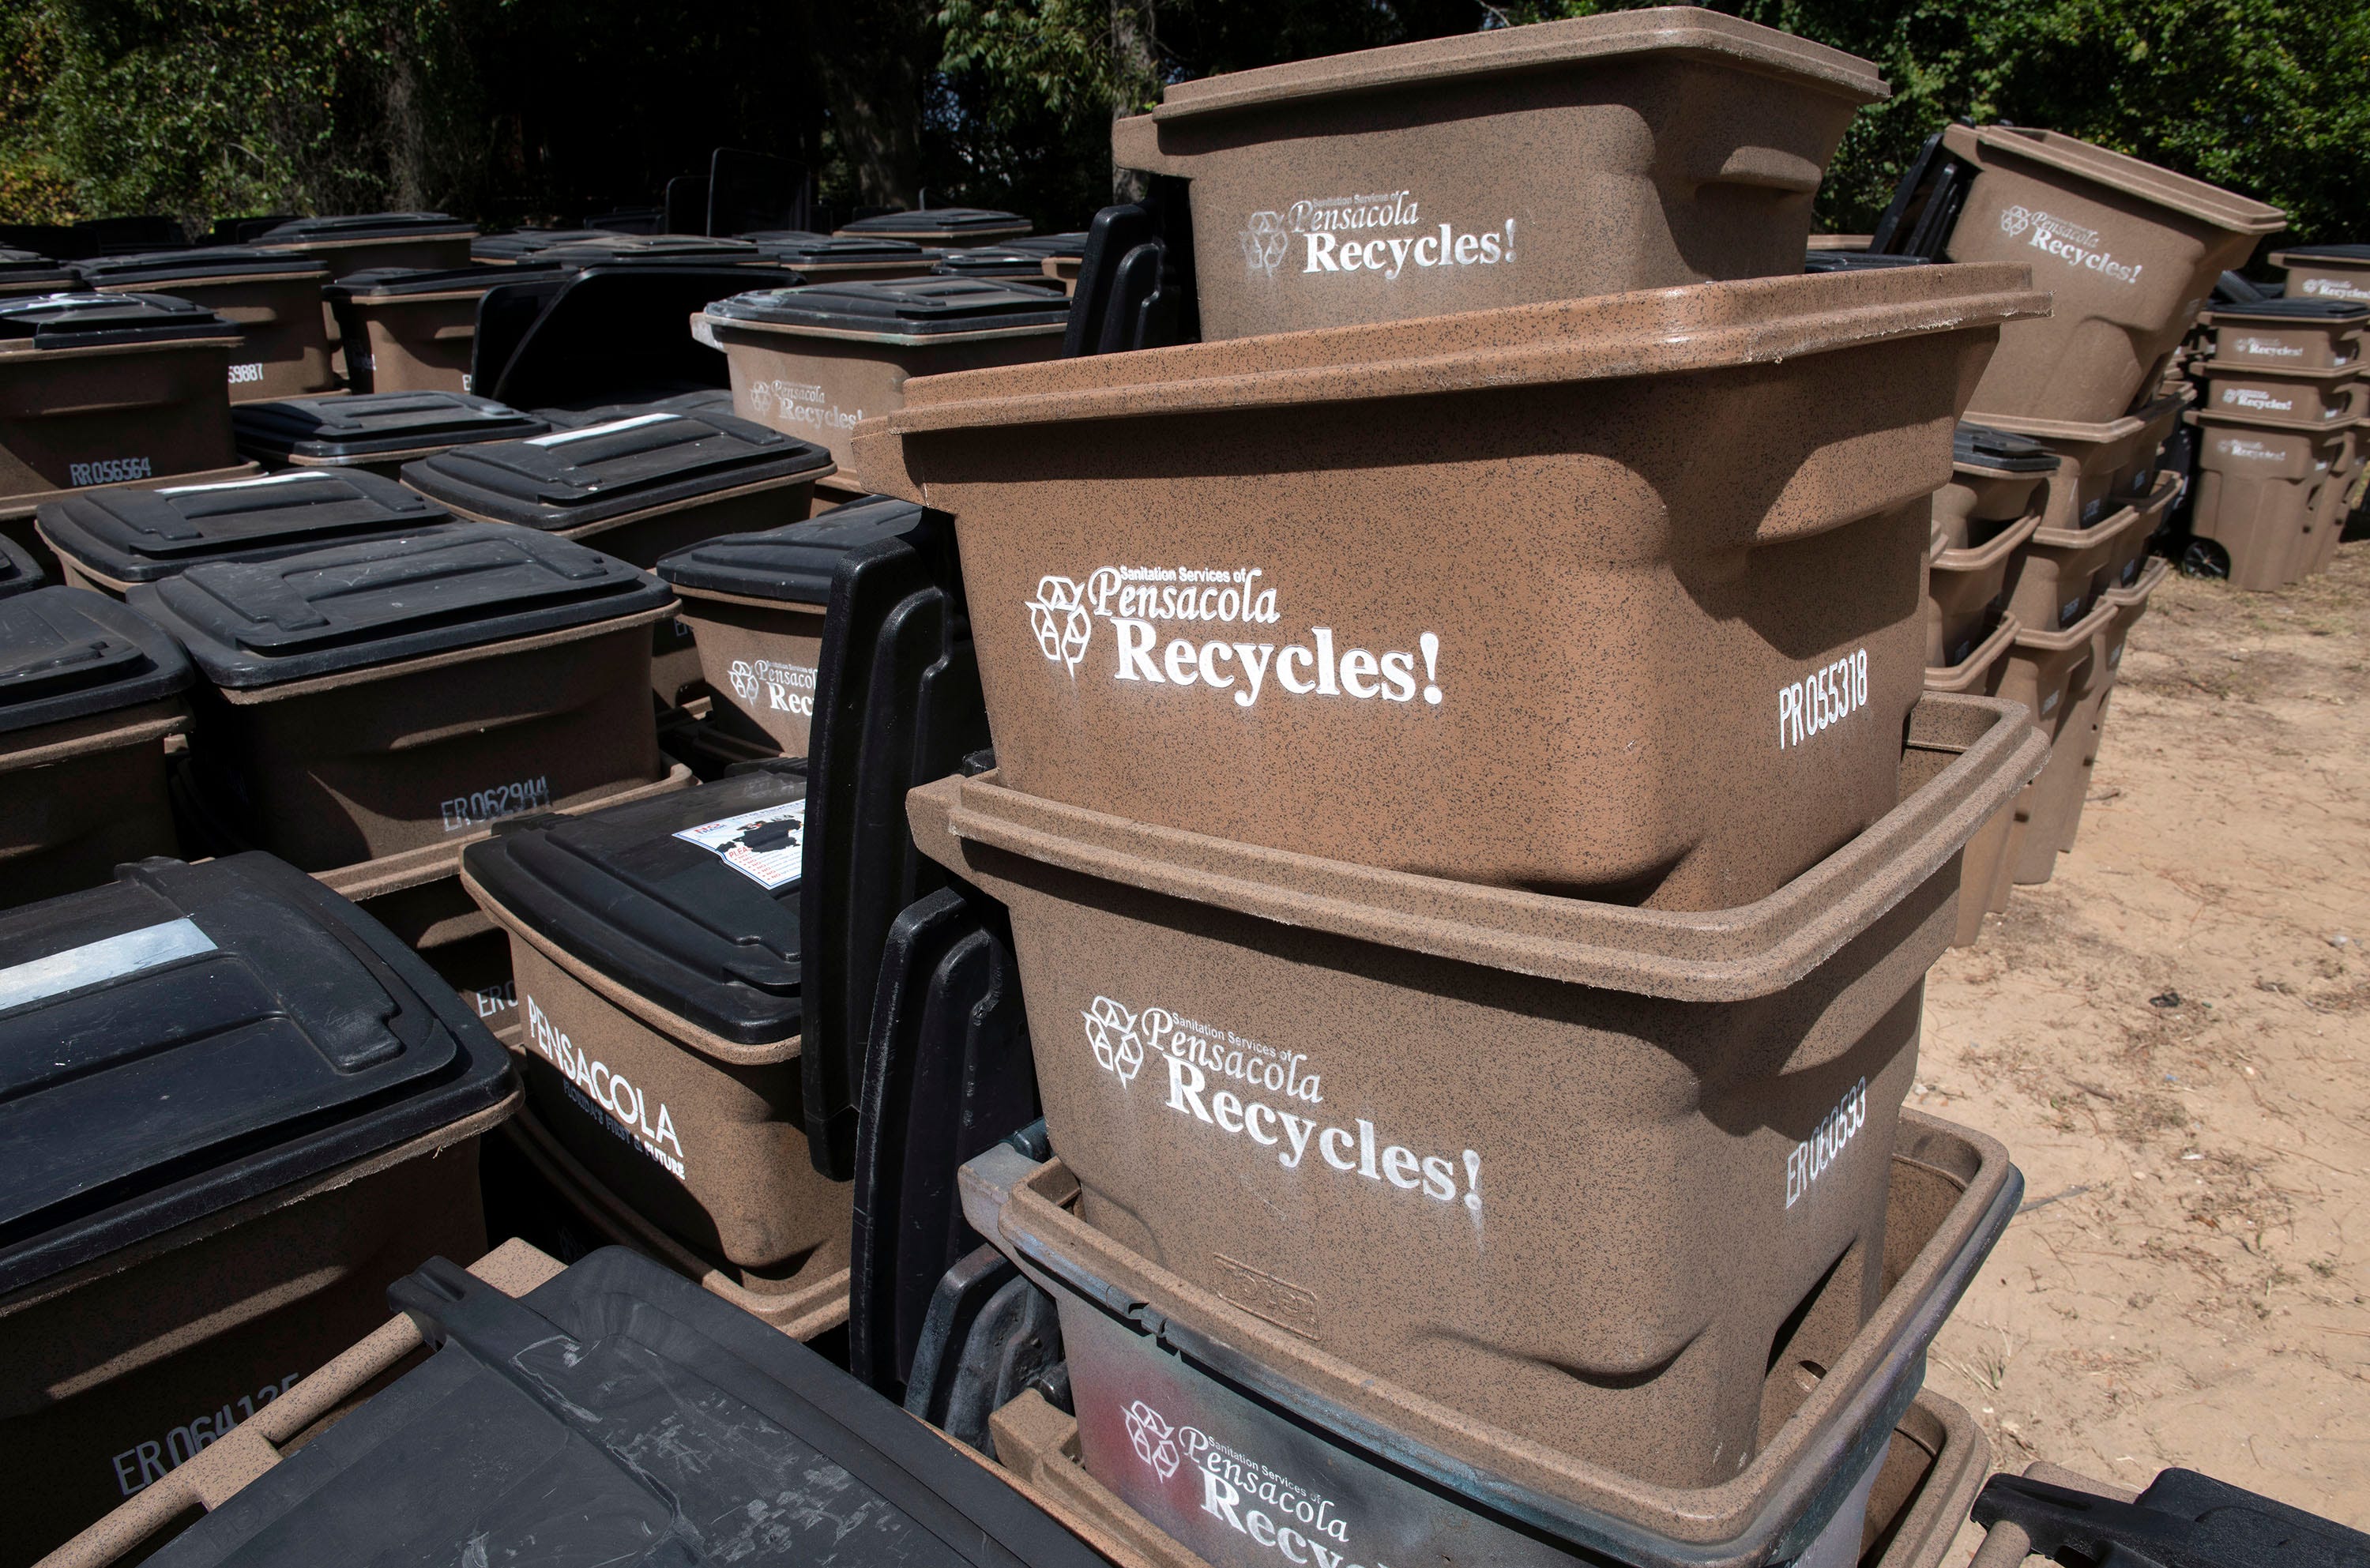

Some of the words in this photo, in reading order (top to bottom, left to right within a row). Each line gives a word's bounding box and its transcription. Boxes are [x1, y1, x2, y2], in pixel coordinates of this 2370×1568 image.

[1288, 190, 1420, 233] Pensacola
[1312, 194, 1353, 209] Sanitation
[1354, 192, 1386, 204] Services
[1388, 191, 1400, 201] of
[1303, 218, 1518, 280] Recycles!
[2028, 227, 2143, 284] Recycles!
[2031, 211, 2101, 248] Pensacola
[771, 380, 826, 404] Pensacola
[70, 457, 152, 487] RR056564
[1088, 566, 1281, 625] Pensacola
[1119, 565, 1176, 582] Sanitation
[1178, 566, 1231, 584] Services
[1232, 568, 1247, 584] of
[754, 660, 818, 690] Pensacol
[1110, 618, 1443, 707] Recycles!
[766, 682, 814, 716] Rec
[1779, 648, 1868, 750] PR055318
[441, 776, 551, 832] ER062944
[476, 980, 519, 1018] ER0
[1142, 1007, 1324, 1104] Pensacola
[1172, 1011, 1224, 1040] Sanitation
[1227, 1030, 1277, 1058] Services
[1278, 1048, 1294, 1062] of
[527, 995, 684, 1158] PENSACOLA
[563, 1077, 604, 1126] FLORIDA'S
[606, 1113, 631, 1145] FIRST
[644, 1141, 686, 1180] FUTURE
[1162, 1053, 1482, 1211] Recycles!
[1179, 1426, 1350, 1543] Pensacola
[1207, 1435, 1259, 1472] Sanitation
[1261, 1464, 1307, 1498] Services
[1198, 1465, 1386, 1568] Recy
